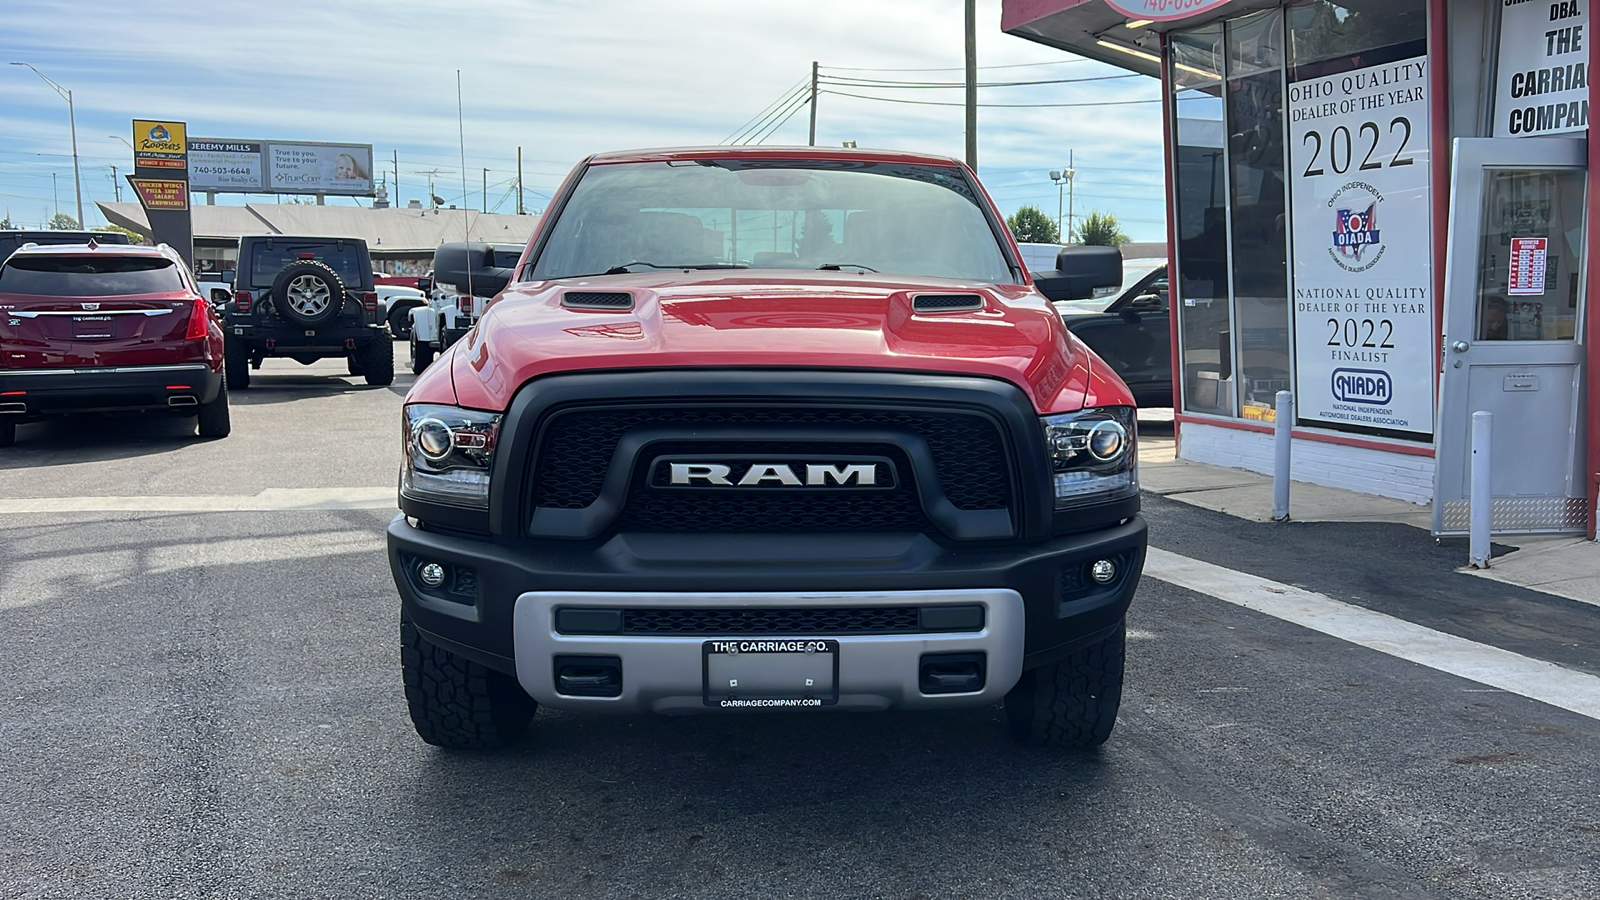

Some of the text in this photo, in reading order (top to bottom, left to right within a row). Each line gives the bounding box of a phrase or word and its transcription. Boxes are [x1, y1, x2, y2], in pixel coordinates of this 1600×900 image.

[1549, 0, 1581, 21] DBA.
[1545, 25, 1583, 56] THE
[1290, 80, 1333, 102] OHIO
[1341, 61, 1426, 95] QUALITY
[1511, 63, 1590, 98] CARRIA
[1292, 86, 1424, 122] DEALER OF THE YEAR
[1509, 100, 1589, 134] COMPAN
[140, 138, 181, 151] Roosters
[191, 143, 251, 152] JEREMY MILLS
[1303, 116, 1414, 177] 2022
[194, 166, 251, 175] 740-503-6648
[231, 176, 248, 185] Realty
[1327, 181, 1385, 208] OHIO INDEPENDENT
[1338, 231, 1372, 245] OIADA
[1328, 247, 1348, 271] AUTOMOBILE
[1365, 244, 1386, 270] ASSOCIATION
[1297, 287, 1427, 300] NATIONAL QUALITY
[1298, 302, 1425, 314] DEALER OF THE YEAR
[1326, 318, 1395, 349] 2022
[1331, 350, 1389, 363] FINALIST
[1336, 375, 1387, 399] NIADA
[1319, 411, 1409, 427] AUTOMOBILE DEALERS ASSOCIATION
[1332, 404, 1393, 416] NATIONAL INDEPENDENT
[669, 462, 877, 486] RAM
[712, 641, 738, 652] THE
[740, 641, 805, 652] CARRIAGE
[720, 698, 822, 707] CARRIAGECOMPANY.COM
